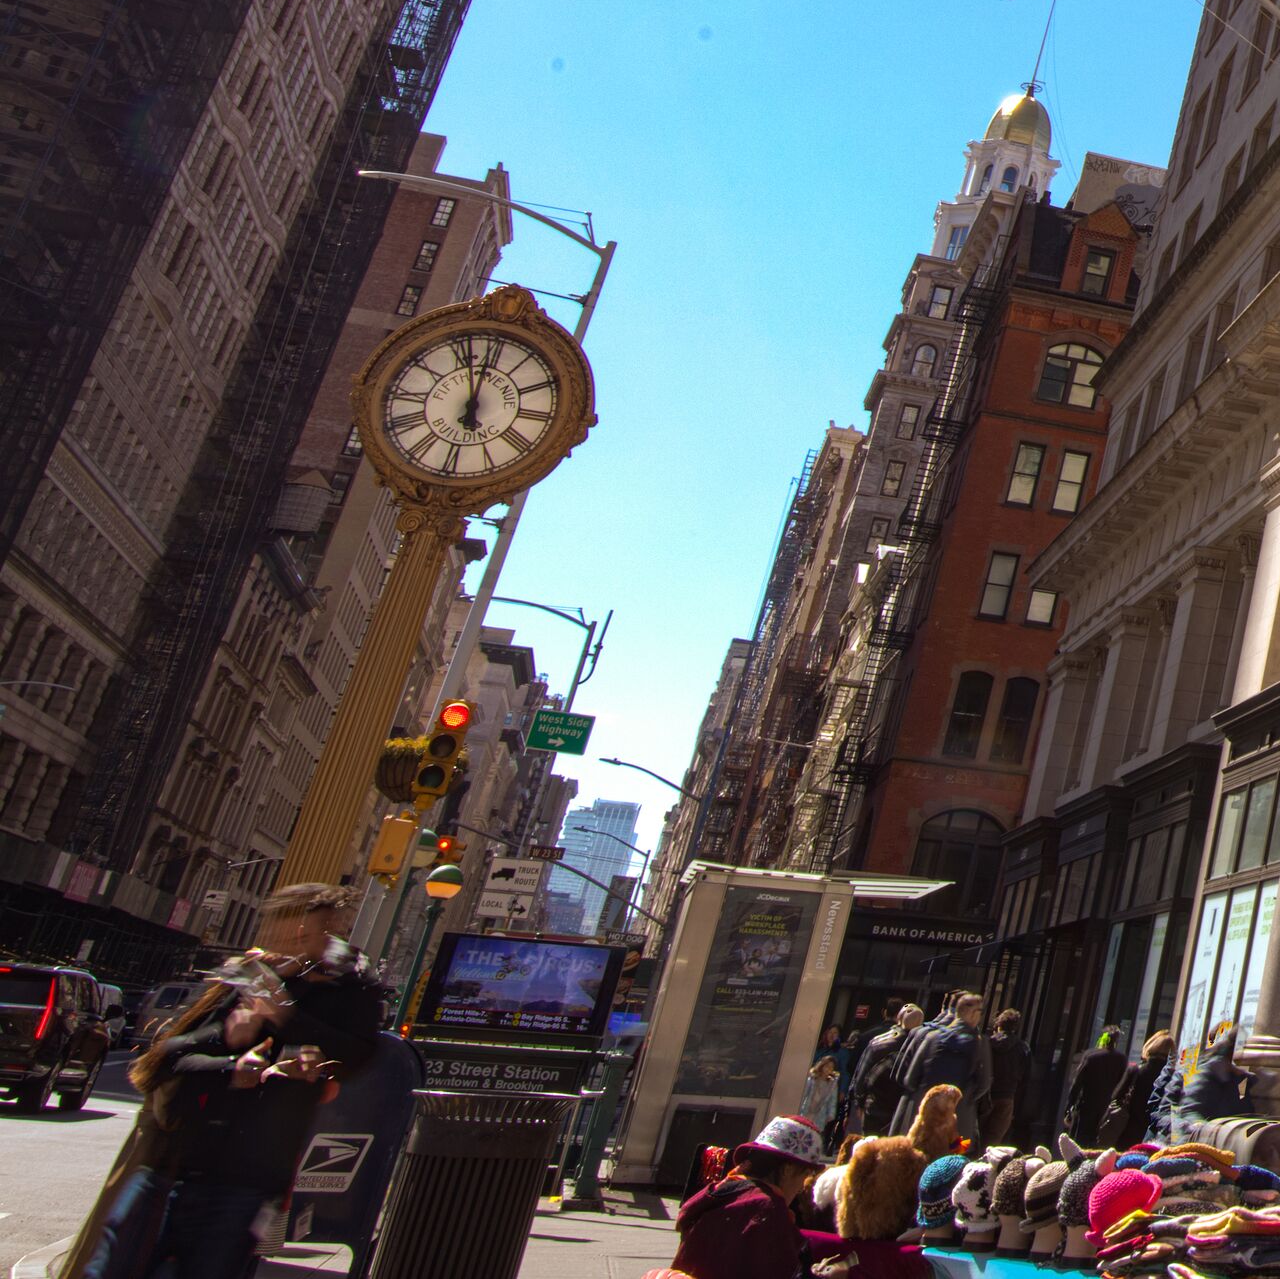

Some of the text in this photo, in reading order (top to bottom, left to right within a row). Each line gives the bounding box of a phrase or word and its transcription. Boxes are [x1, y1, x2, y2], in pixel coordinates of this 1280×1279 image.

[432, 372, 470, 401] FIFTH
[432, 417, 500, 443] BUILDING
[540, 713, 590, 728] West Side
[538, 724, 583, 739] Highway
[481, 901, 503, 909] LOCAL
[756, 893, 791, 902] JCDecaux
[608, 932, 625, 940] HOT
[815, 900, 842, 970] Newsstand
[872, 925, 983, 944] BANK OF AMERICA
[466, 950, 505, 966] THE
[449, 1061, 497, 1078] Street
[503, 1065, 560, 1081] Station
[426, 1077, 544, 1092] owntown & Brooklyn
